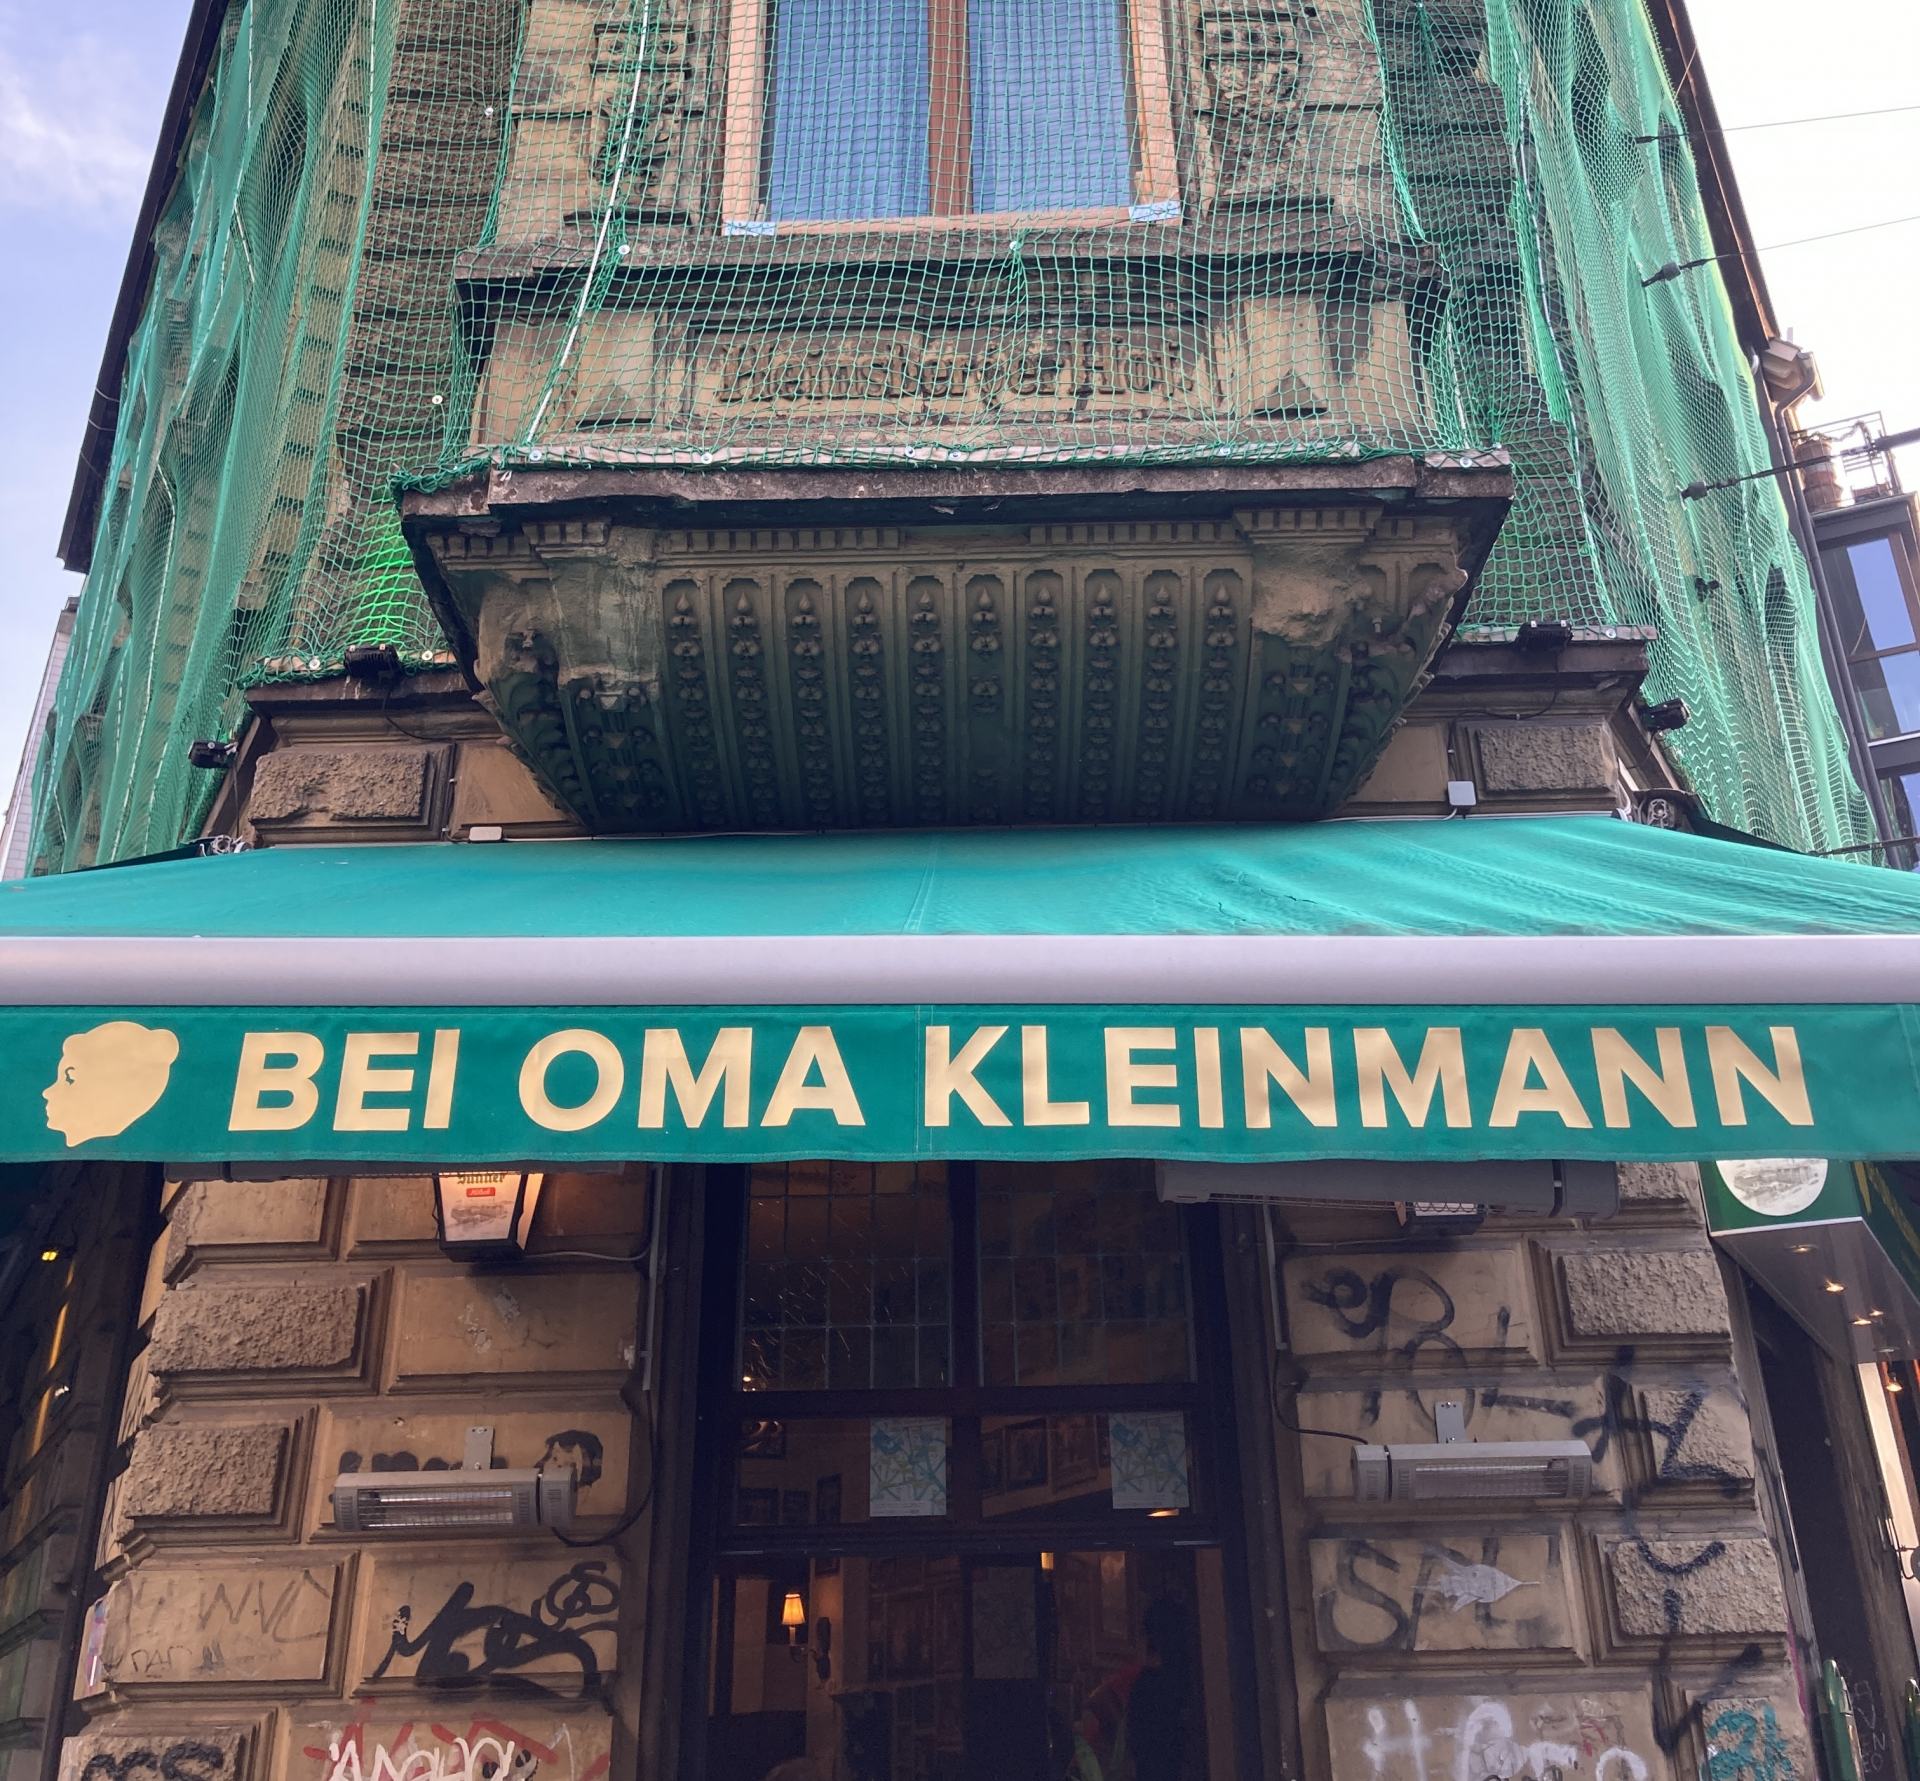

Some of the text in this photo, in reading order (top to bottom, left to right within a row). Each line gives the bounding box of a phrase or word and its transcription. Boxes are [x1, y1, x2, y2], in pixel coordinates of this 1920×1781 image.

[228, 1025, 1815, 1131] BEI OMA KLEINMANN
